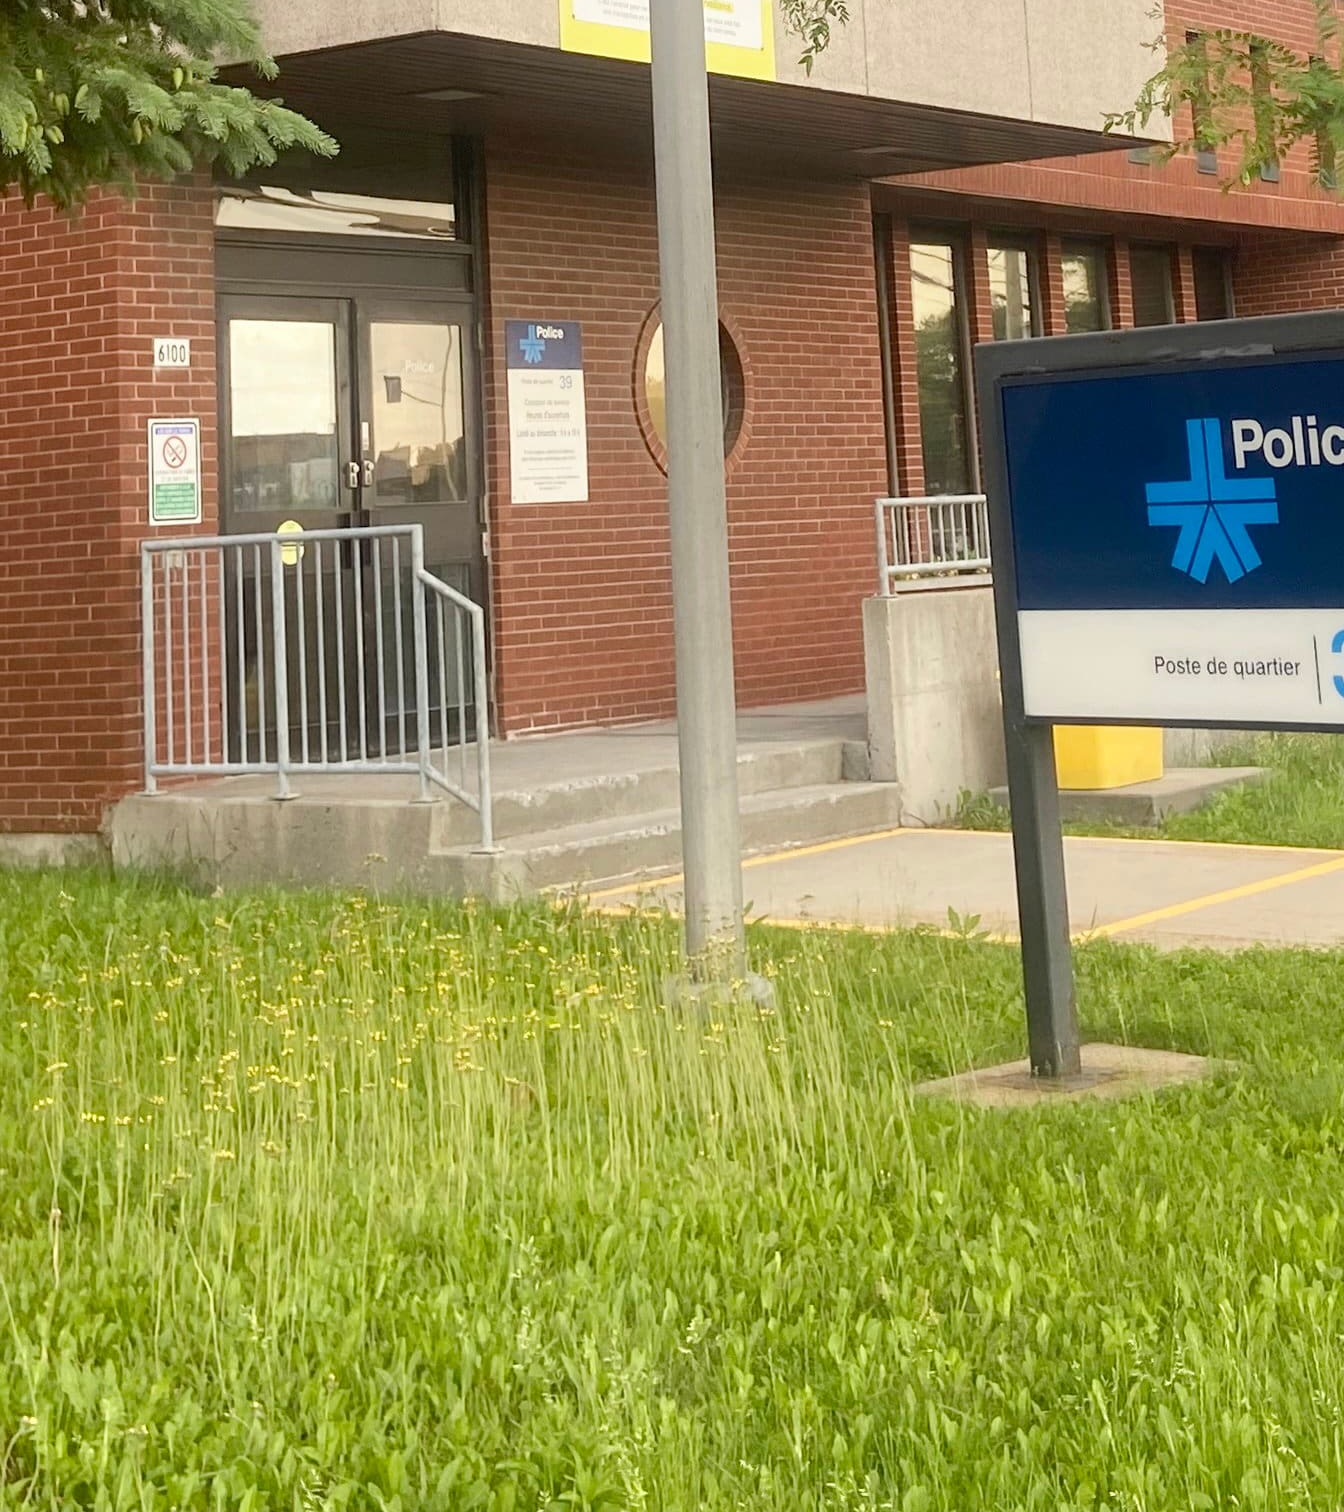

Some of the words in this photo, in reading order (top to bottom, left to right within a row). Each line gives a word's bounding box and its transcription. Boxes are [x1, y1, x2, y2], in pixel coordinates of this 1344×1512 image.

[536, 325, 564, 340] Police
[158, 344, 186, 363] 6100
[559, 375, 573, 390] 39
[1154, 655, 1202, 676] Poste
[1206, 655, 1228, 676] de
[1233, 656, 1301, 680] quartier
